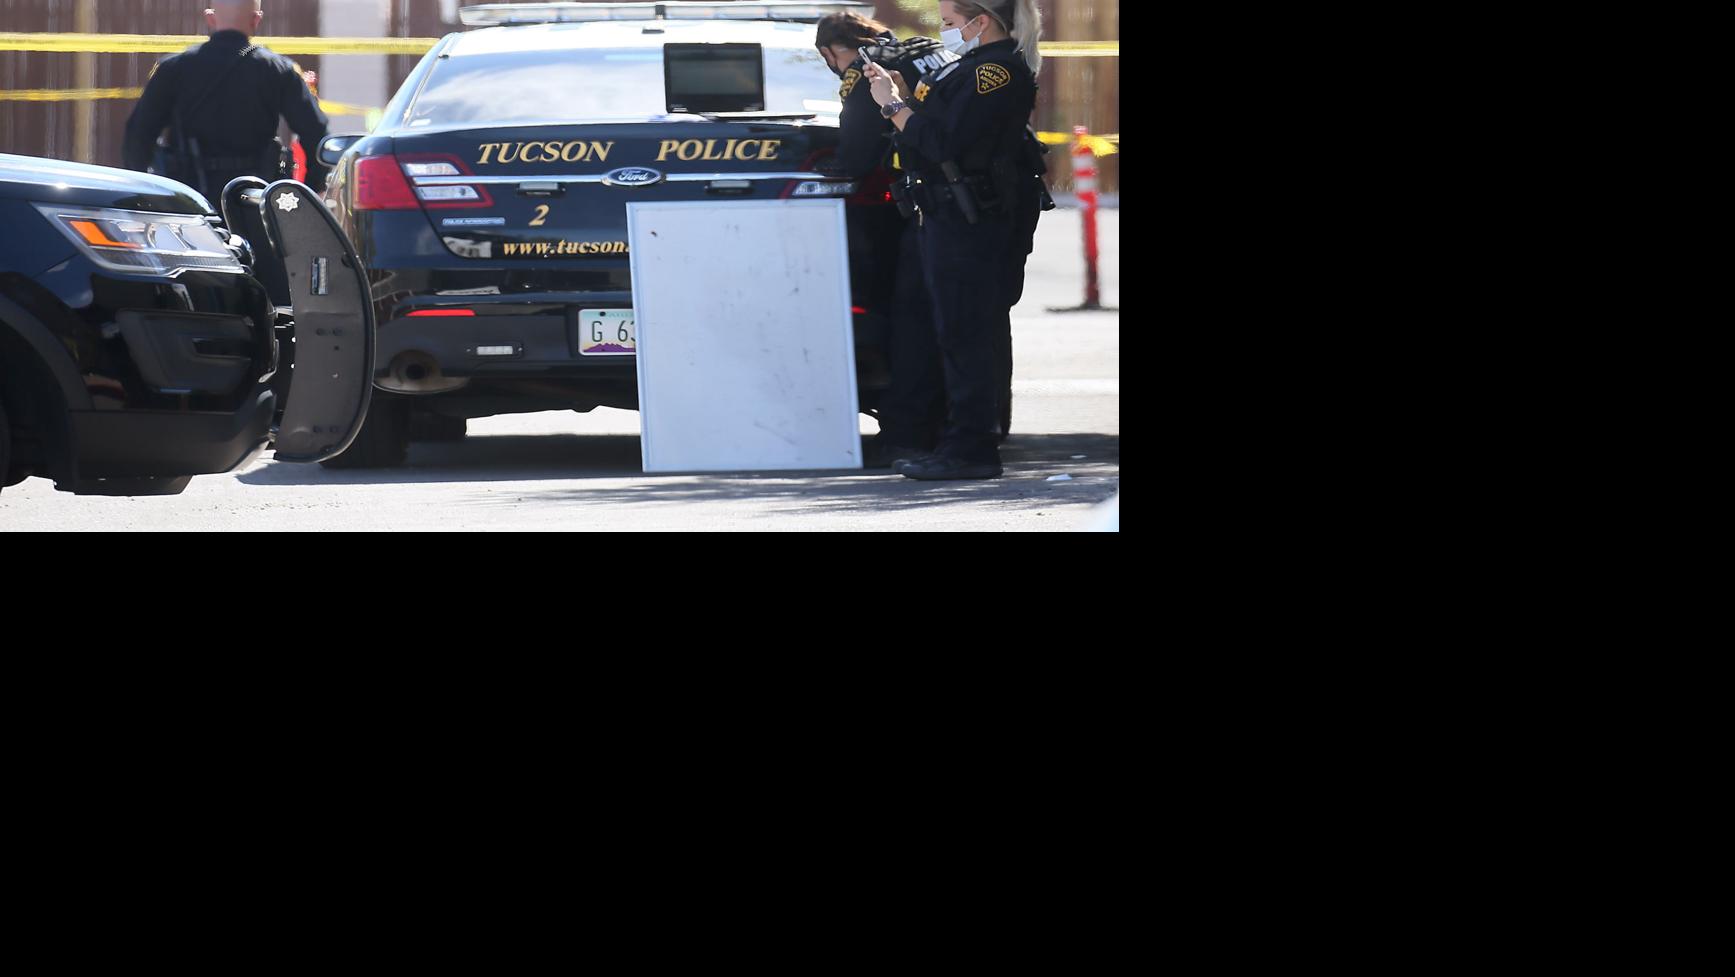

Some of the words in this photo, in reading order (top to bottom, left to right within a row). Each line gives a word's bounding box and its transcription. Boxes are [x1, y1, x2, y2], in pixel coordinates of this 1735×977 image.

[477, 141, 614, 164] TUCSON
[656, 139, 781, 161] POLICE
[618, 170, 648, 181] Ford
[528, 204, 549, 226] 2
[592, 320, 603, 342] G
